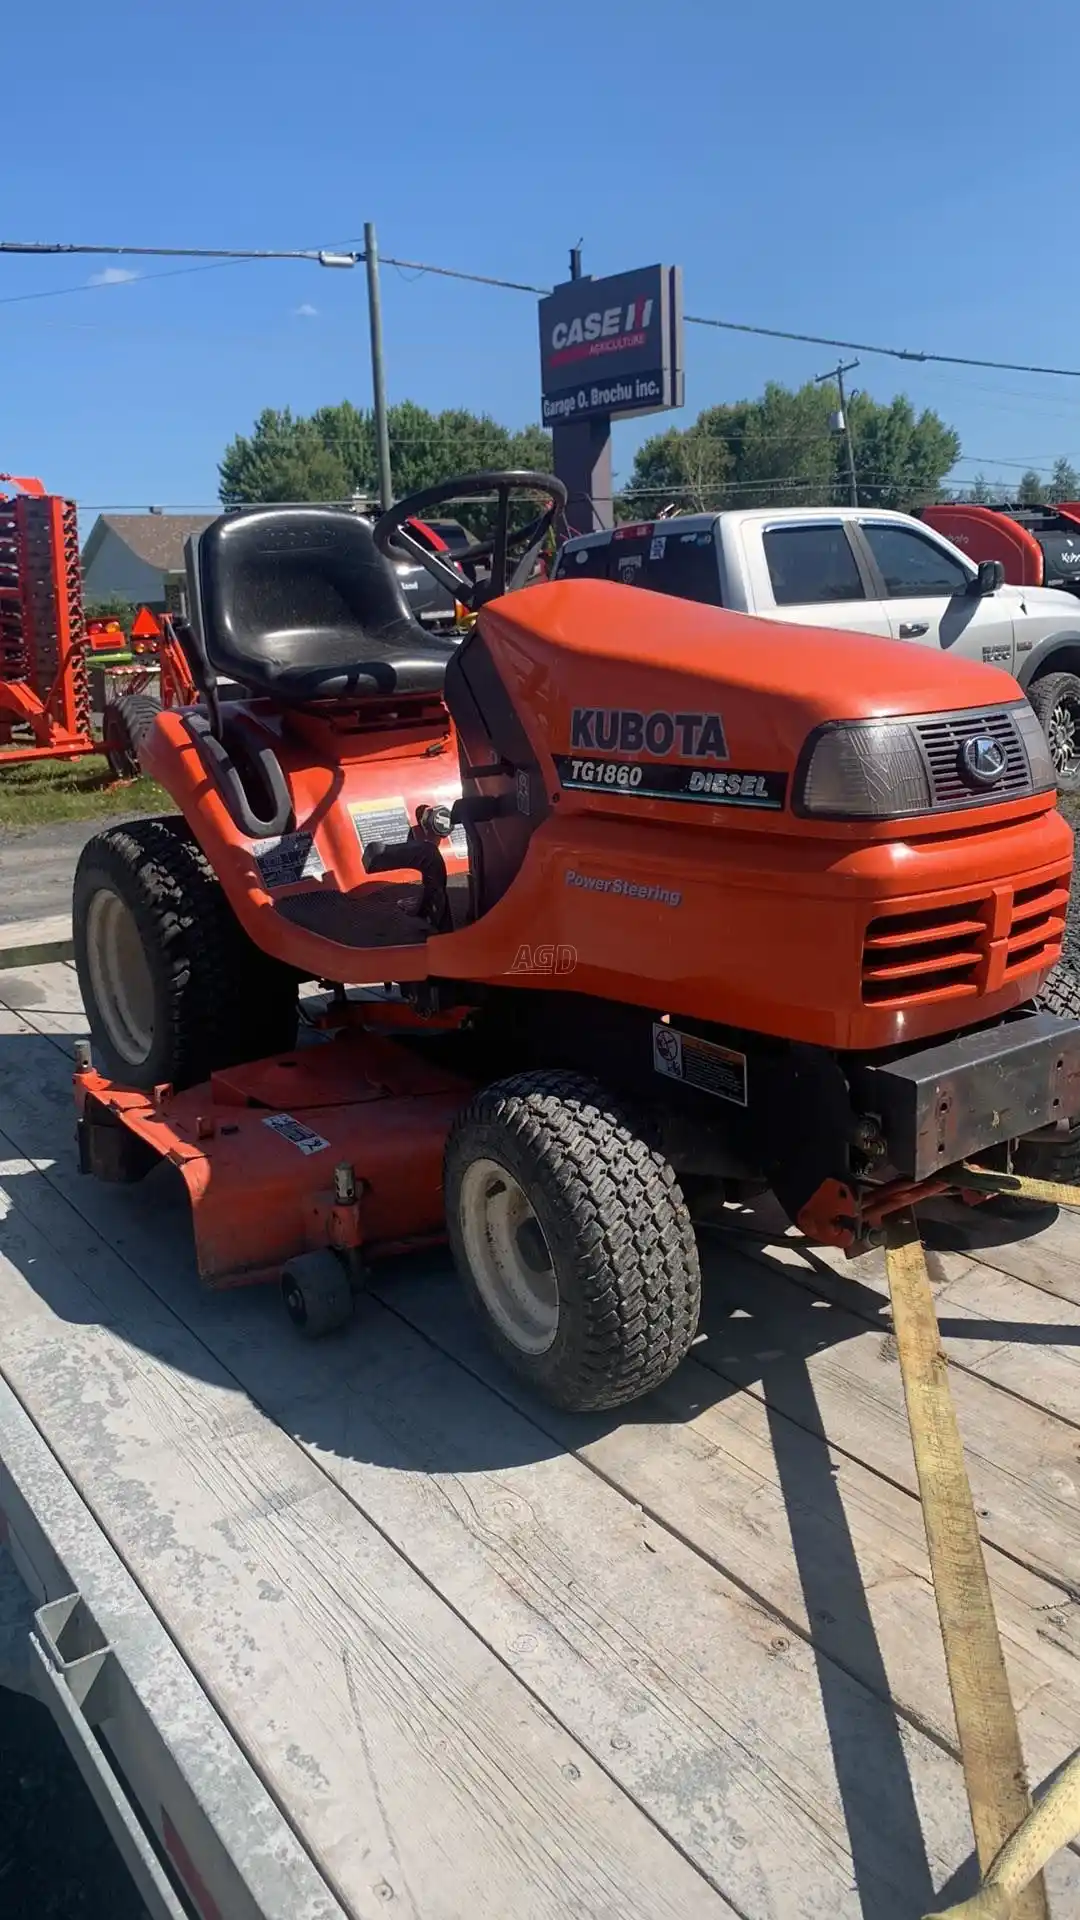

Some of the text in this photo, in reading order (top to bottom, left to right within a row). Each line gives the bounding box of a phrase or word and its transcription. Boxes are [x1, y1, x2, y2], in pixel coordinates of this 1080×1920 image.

[552, 306, 622, 349] CASE
[544, 378, 660, 417] Garage O. Brochu inc.
[570, 707, 730, 760] KUBOTA
[571, 760, 769, 797] TG1860 DIESEL
